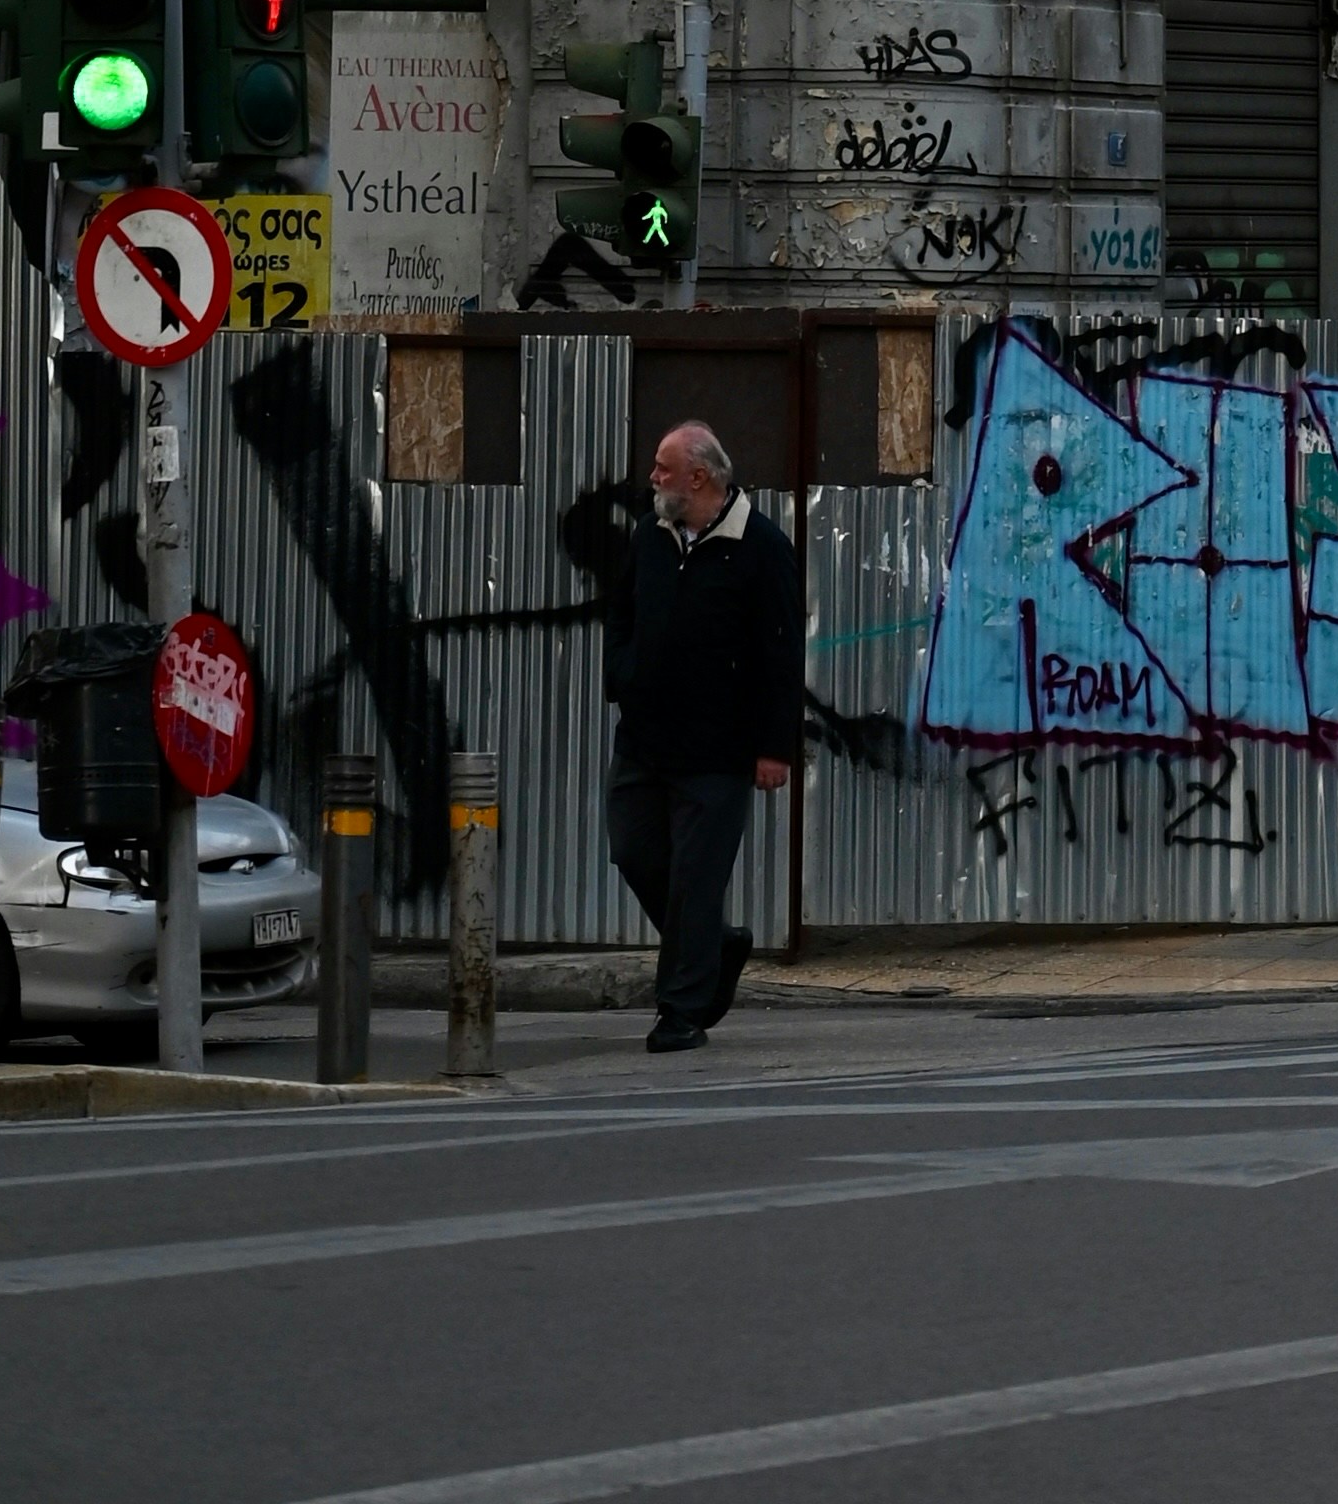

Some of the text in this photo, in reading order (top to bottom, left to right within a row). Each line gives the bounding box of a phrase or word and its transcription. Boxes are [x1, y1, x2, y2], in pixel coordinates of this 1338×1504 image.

[338, 57, 379, 76] EAU
[353, 84, 487, 133] Avène
[261, 209, 322, 250] σας
